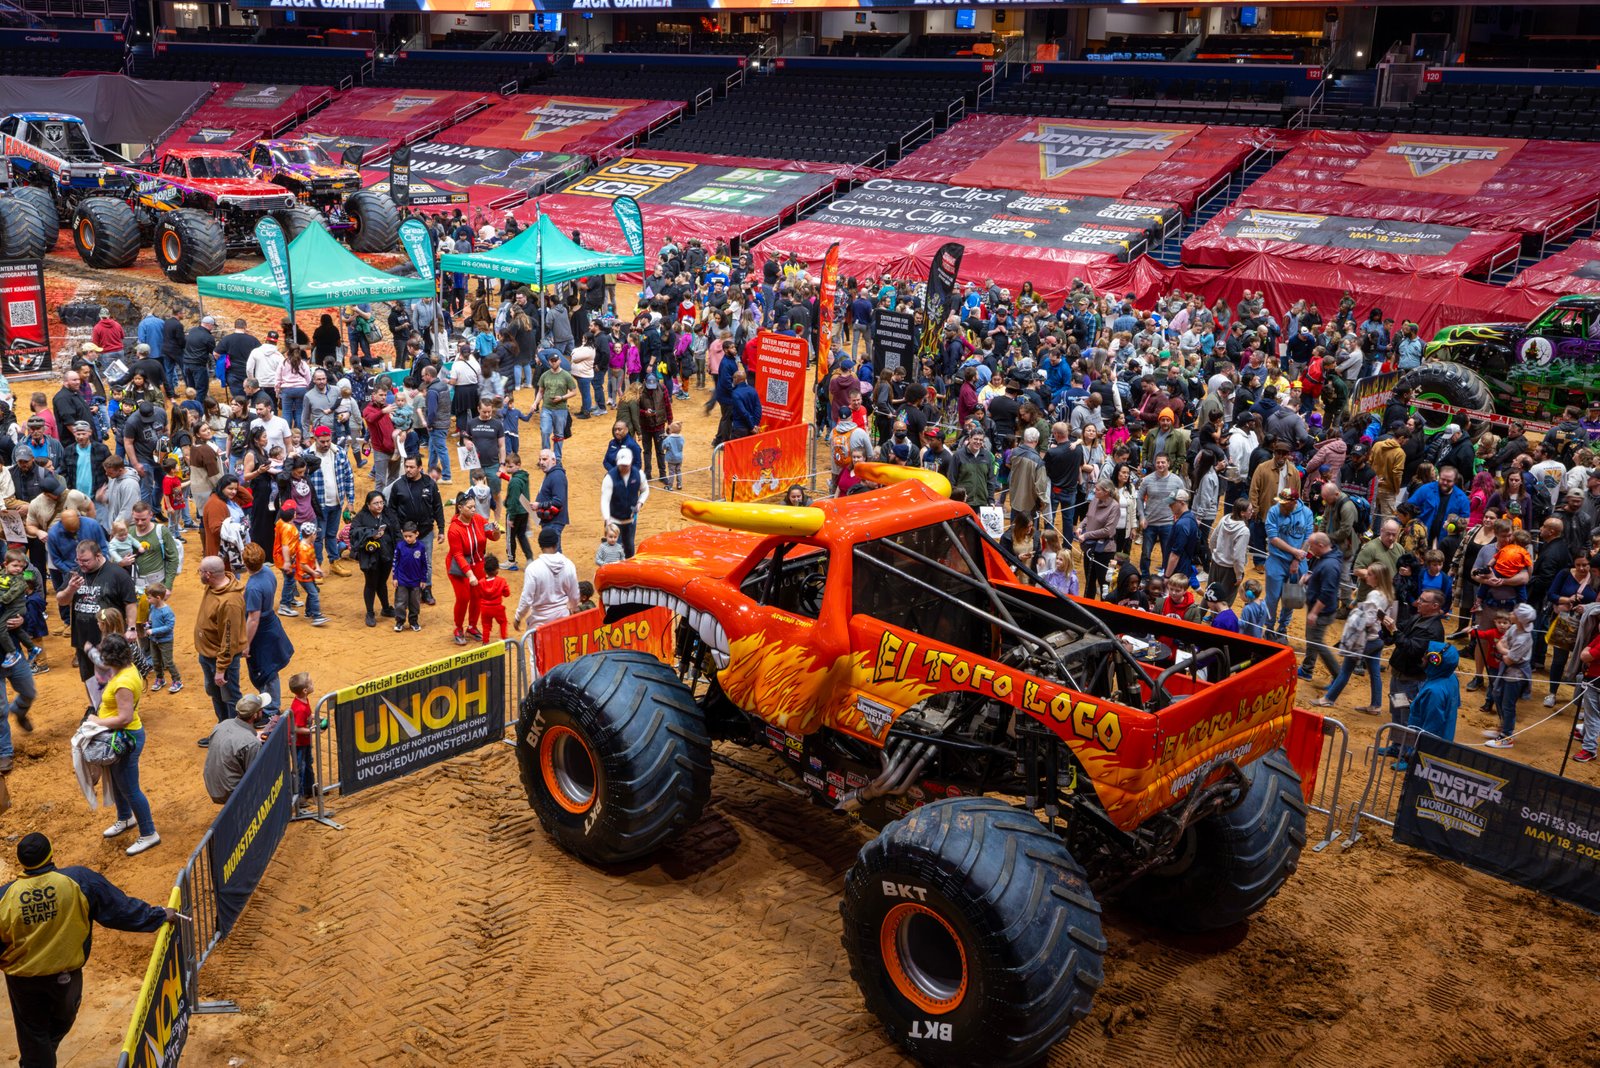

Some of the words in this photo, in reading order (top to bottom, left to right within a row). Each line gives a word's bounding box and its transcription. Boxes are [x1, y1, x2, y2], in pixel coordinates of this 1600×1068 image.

[1309, 70, 1321, 78] 121
[1426, 72, 1440, 81] 120
[1016, 132, 1174, 150] MONSTER
[1041, 145, 1118, 158] JAM
[609, 164, 686, 178] JCB
[722, 170, 800, 184] BKT
[574, 180, 650, 196] JCB
[863, 178, 936, 196] Great
[941, 186, 1006, 202] Clips
[688, 190, 766, 204] BKT
[853, 193, 880, 201] IT'S
[880, 194, 918, 206] GONNA
[939, 202, 982, 211] GREAT
[1017, 196, 1068, 206] SUPER
[828, 200, 902, 218] Great
[906, 208, 972, 225] Clips
[1096, 210, 1138, 220] GLUE
[1106, 204, 1162, 214] SUPER
[817, 214, 839, 223] IT'S
[842, 217, 882, 228] GONNA
[904, 225, 948, 234] GREAT
[983, 218, 1034, 229] SUPER
[1242, 216, 1320, 228] MONSTER
[260, 230, 276, 238] Clips
[402, 226, 426, 234] Great
[1072, 228, 1128, 239] SUPER
[1241, 228, 1268, 236] WORLD
[1269, 229, 1298, 238] FINALS
[1349, 232, 1374, 240] MAY
[1374, 234, 1390, 242] 18,
[1386, 230, 1441, 240] Stadium
[404, 234, 424, 243] Clips
[501, 266, 520, 274] GREAT
[274, 266, 289, 295] FREE
[308, 278, 357, 288] Great
[227, 284, 245, 292] GONNA
[254, 288, 272, 296] GREAT
[326, 291, 340, 299] IT'S
[342, 289, 368, 298] GONNA
[382, 286, 406, 294] GREAT
[892, 332, 912, 340] ANDERSON
[761, 344, 790, 354] AUTOGRAPH
[762, 337, 778, 346] ENTER
[778, 340, 790, 348] HERE
[791, 342, 800, 350] FOR
[758, 354, 782, 365] ARMANDO
[782, 358, 802, 368] CASTRO
[768, 366, 783, 376] TORO
[784, 369, 796, 378] LOCO
[356, 678, 392, 696] Official
[396, 658, 452, 684] Educational
[454, 650, 489, 666] Partner
[354, 672, 488, 753] UNOH
[856, 702, 892, 724] MONSTER
[866, 714, 882, 726] JAM
[526, 709, 546, 749] BKT
[356, 746, 400, 766] UNIVERSITY
[402, 742, 411, 751] OF
[411, 723, 468, 748] NORTHWESTERN
[469, 716, 486, 728] OHIO
[357, 726, 488, 781] UNOH.EDU/MONSTERJAM
[1414, 764, 1502, 804] MONSTER
[1434, 786, 1475, 808] JAM
[584, 797, 602, 836] BKT
[1420, 798, 1452, 814] WORLD
[1452, 808, 1484, 828] FINALS
[1520, 806, 1551, 826] SoFi
[223, 770, 284, 884] MONSTERJAM.COM
[1524, 826, 1555, 843] MAY
[1557, 836, 1574, 852] 18,
[1576, 844, 1600, 860] 202
[20, 886, 56, 905] CSC
[882, 880, 928, 901] BKT
[22, 900, 57, 916] EVENT
[23, 911, 58, 926] STAFF
[908, 1020, 953, 1042] BKT
